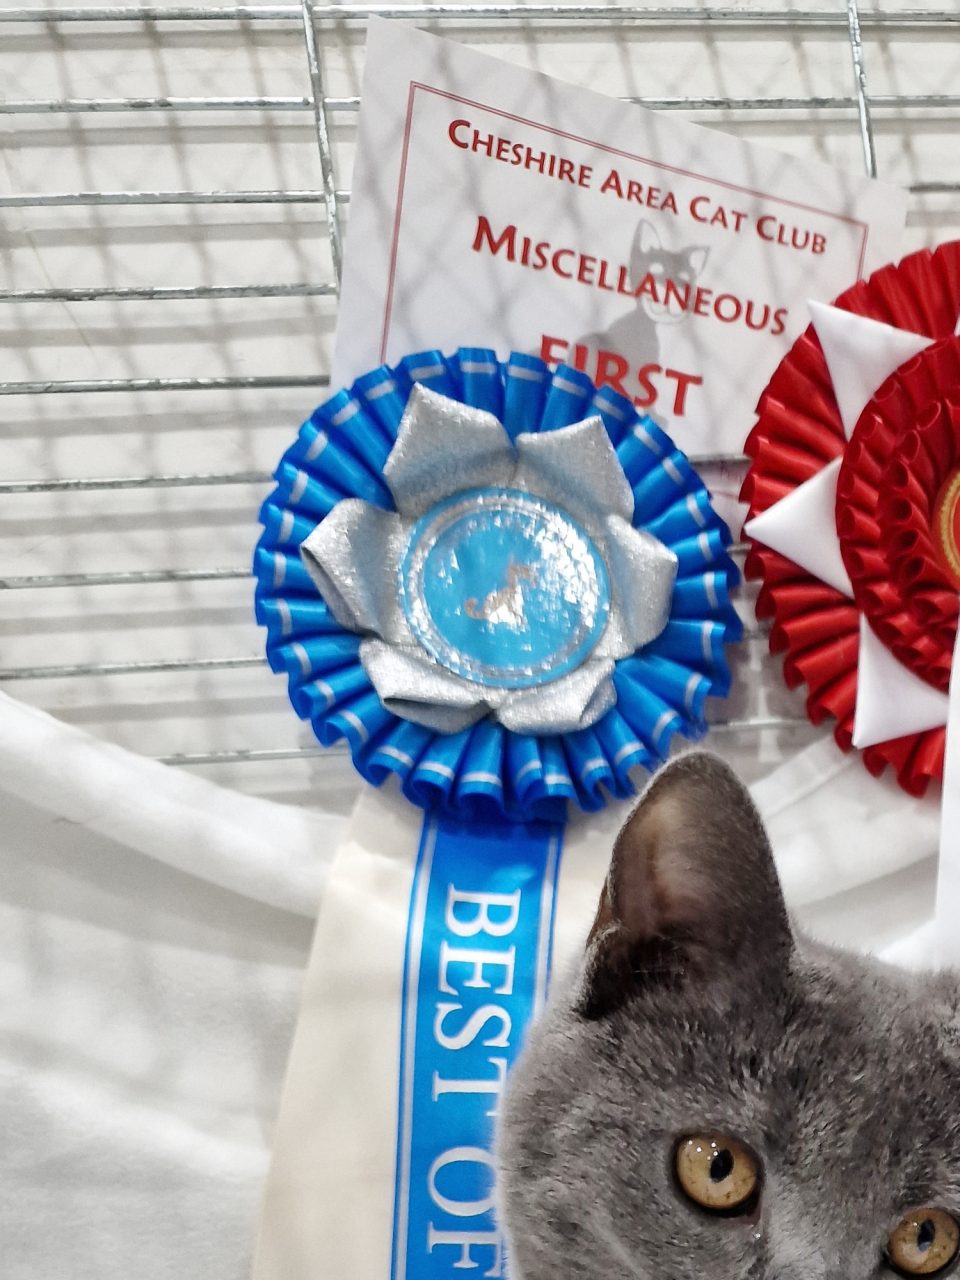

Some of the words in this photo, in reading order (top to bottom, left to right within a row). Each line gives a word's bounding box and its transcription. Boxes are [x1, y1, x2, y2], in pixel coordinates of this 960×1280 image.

[447, 118, 592, 189] CHESHIRE
[600, 169, 679, 215] AREA
[687, 196, 747, 233] CAT
[755, 215, 828, 256] CLUB
[472, 214, 789, 338] MISCELLANEOUS
[431, 882, 522, 1117] BEST
[425, 1144, 503, 1279] OF
